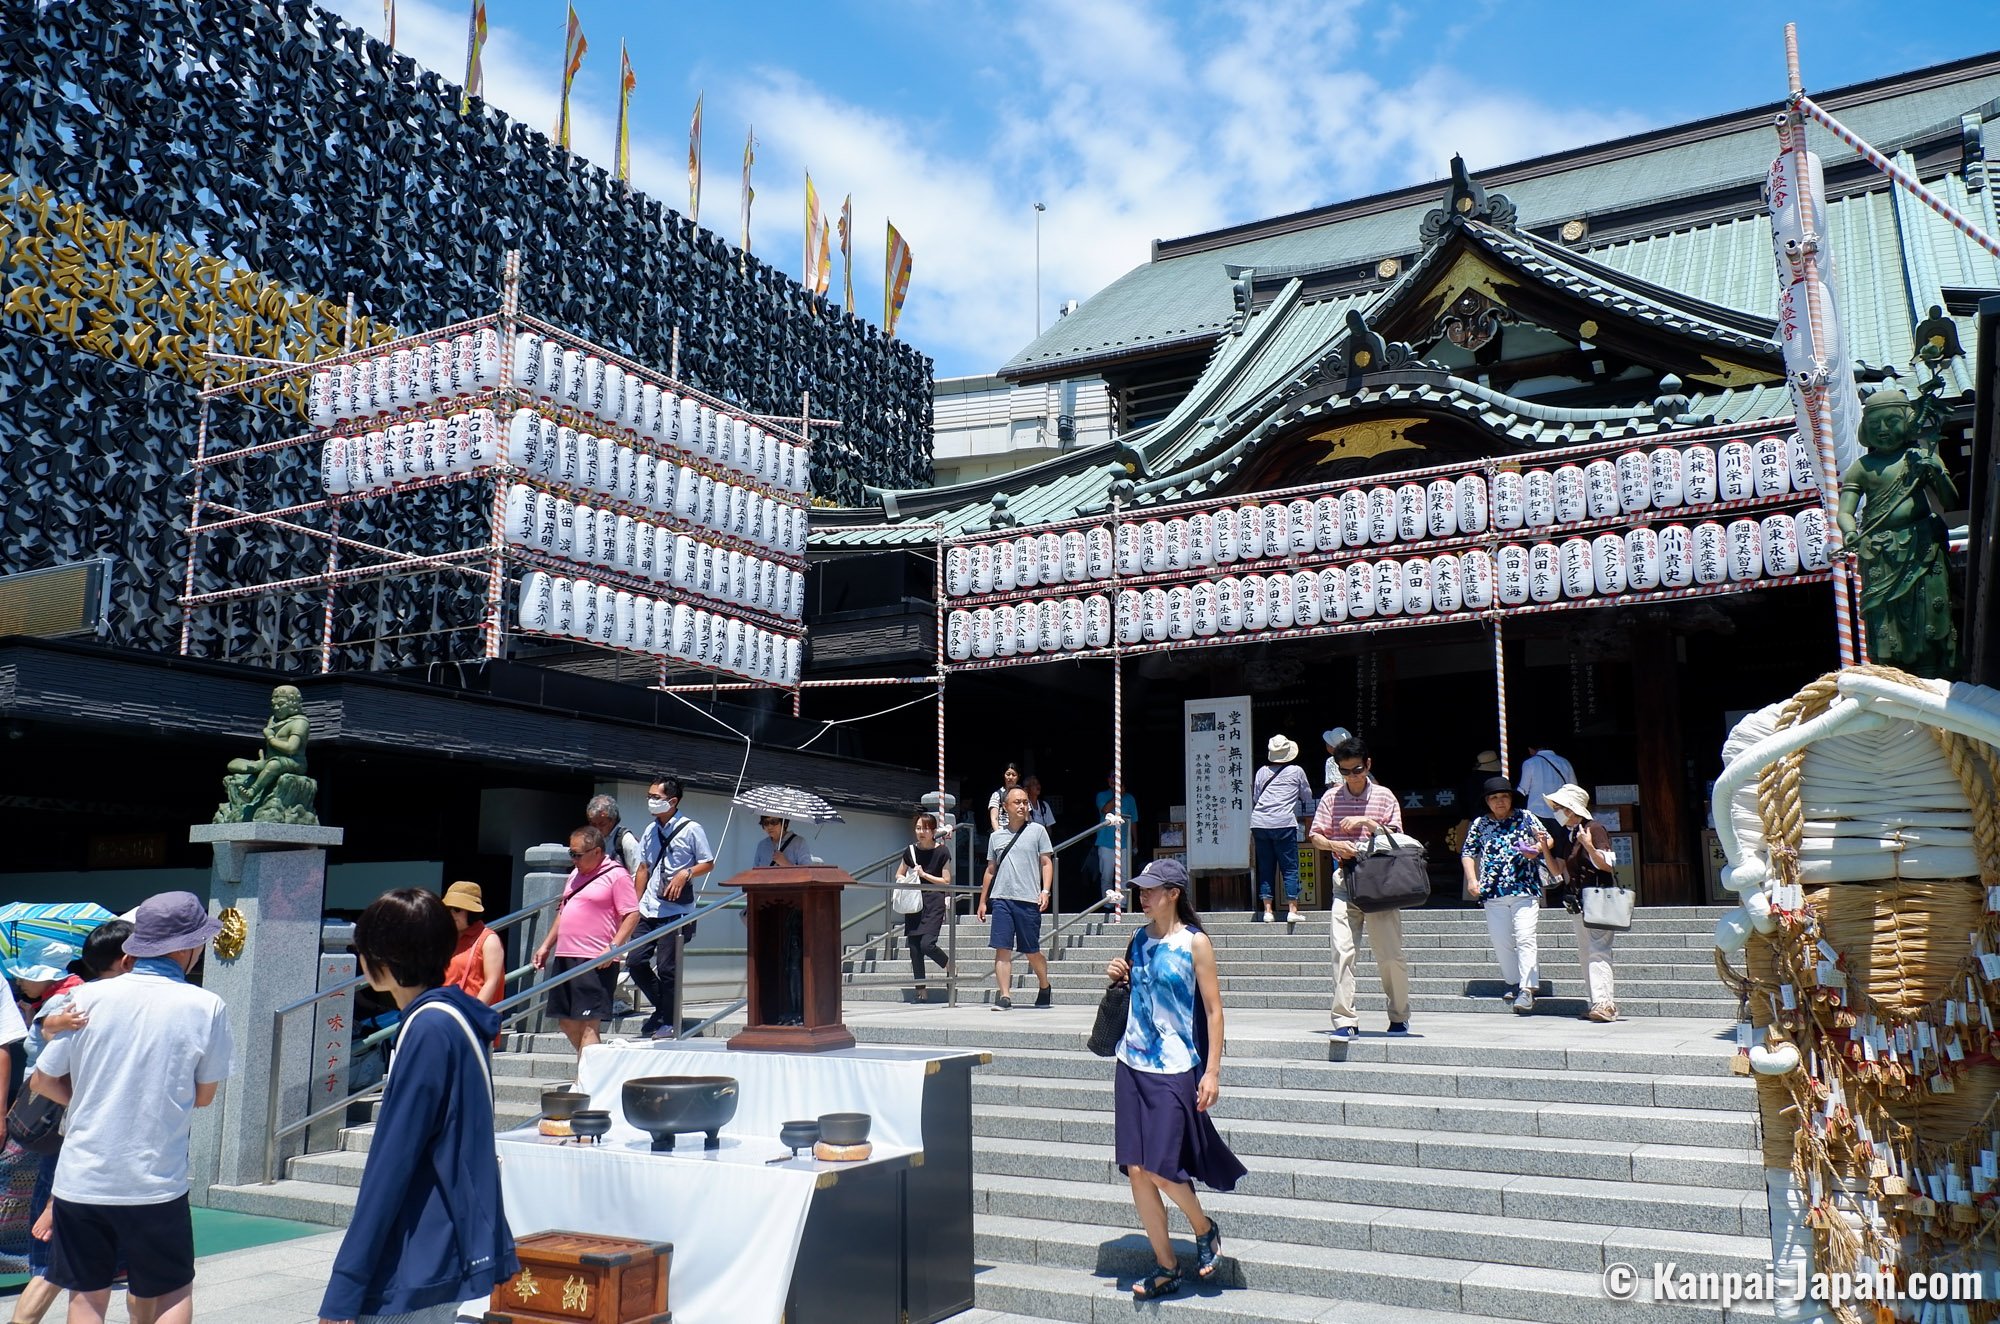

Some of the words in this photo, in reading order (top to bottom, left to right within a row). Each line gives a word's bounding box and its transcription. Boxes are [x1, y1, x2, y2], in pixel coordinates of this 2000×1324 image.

[326, 992, 345, 1093] 味ハナ子
[513, 1266, 588, 1312] 奉納
